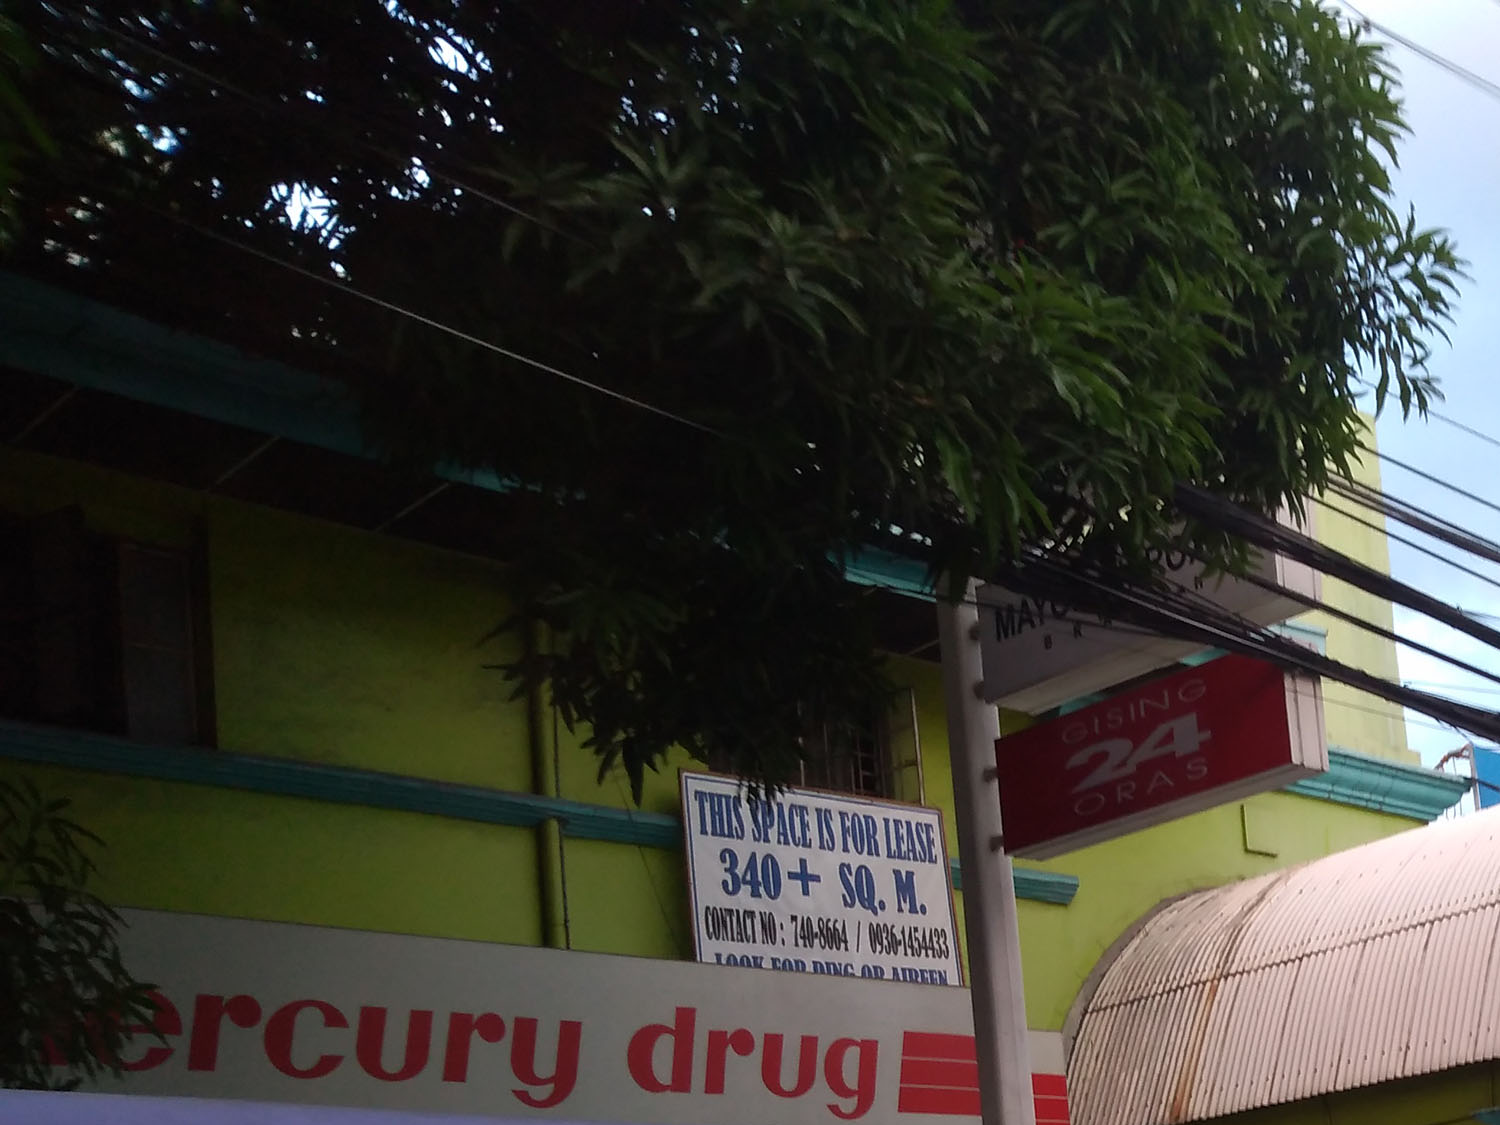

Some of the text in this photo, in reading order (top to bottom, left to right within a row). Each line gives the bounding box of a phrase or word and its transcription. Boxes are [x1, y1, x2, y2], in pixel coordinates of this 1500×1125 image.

[995, 597, 1082, 641] MAYO
[1062, 679, 1207, 745] GISING
[1065, 712, 1211, 794] 24
[1074, 757, 1208, 816] ORAS
[694, 791, 938, 865] THIS SPACE IS FOR LEASE
[839, 862, 886, 916] SQ.
[893, 869, 927, 916] M.
[704, 906, 757, 944] CONTACT
[790, 914, 849, 953] 740-8664
[38, 990, 878, 1120] ercury drug
